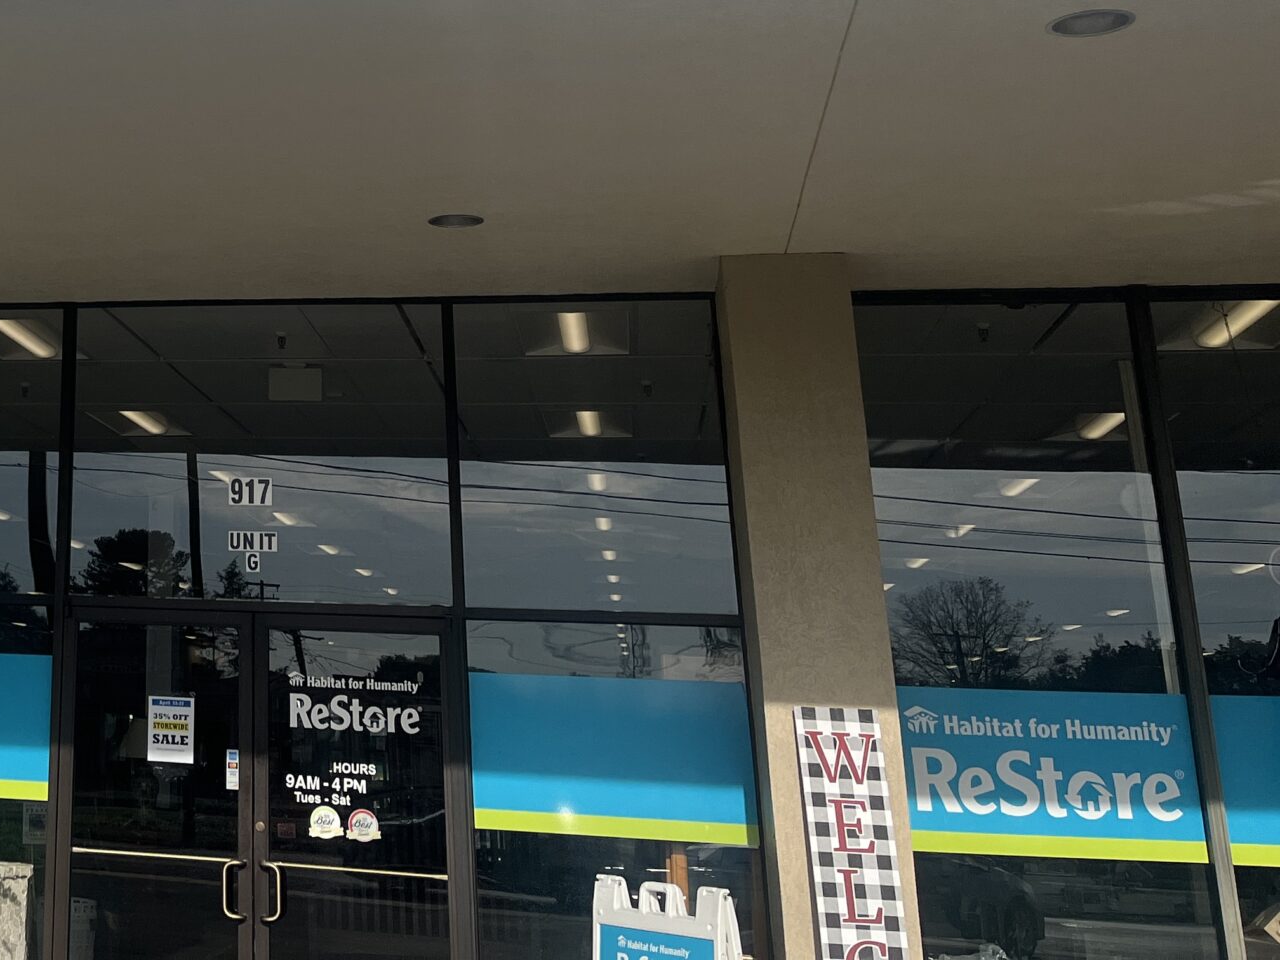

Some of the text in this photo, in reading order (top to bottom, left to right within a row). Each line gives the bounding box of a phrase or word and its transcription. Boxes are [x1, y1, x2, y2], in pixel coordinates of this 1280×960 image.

[230, 478, 270, 504] 917
[247, 553, 258, 571] G
[306, 676, 419, 694] Habitat for Humanity
[172, 713, 190, 721] OFF
[152, 721, 189, 731] STOREWIDE
[942, 714, 1024, 738] Habitat
[1028, 717, 1060, 739] for
[152, 733, 189, 746] SALE
[285, 773, 321, 790] 9AM
[293, 791, 322, 804] Tues
[331, 793, 351, 806] Sat
[627, 939, 649, 951] Habitat
[649, 942, 660, 953] for
[659, 945, 690, 959] Humanity
